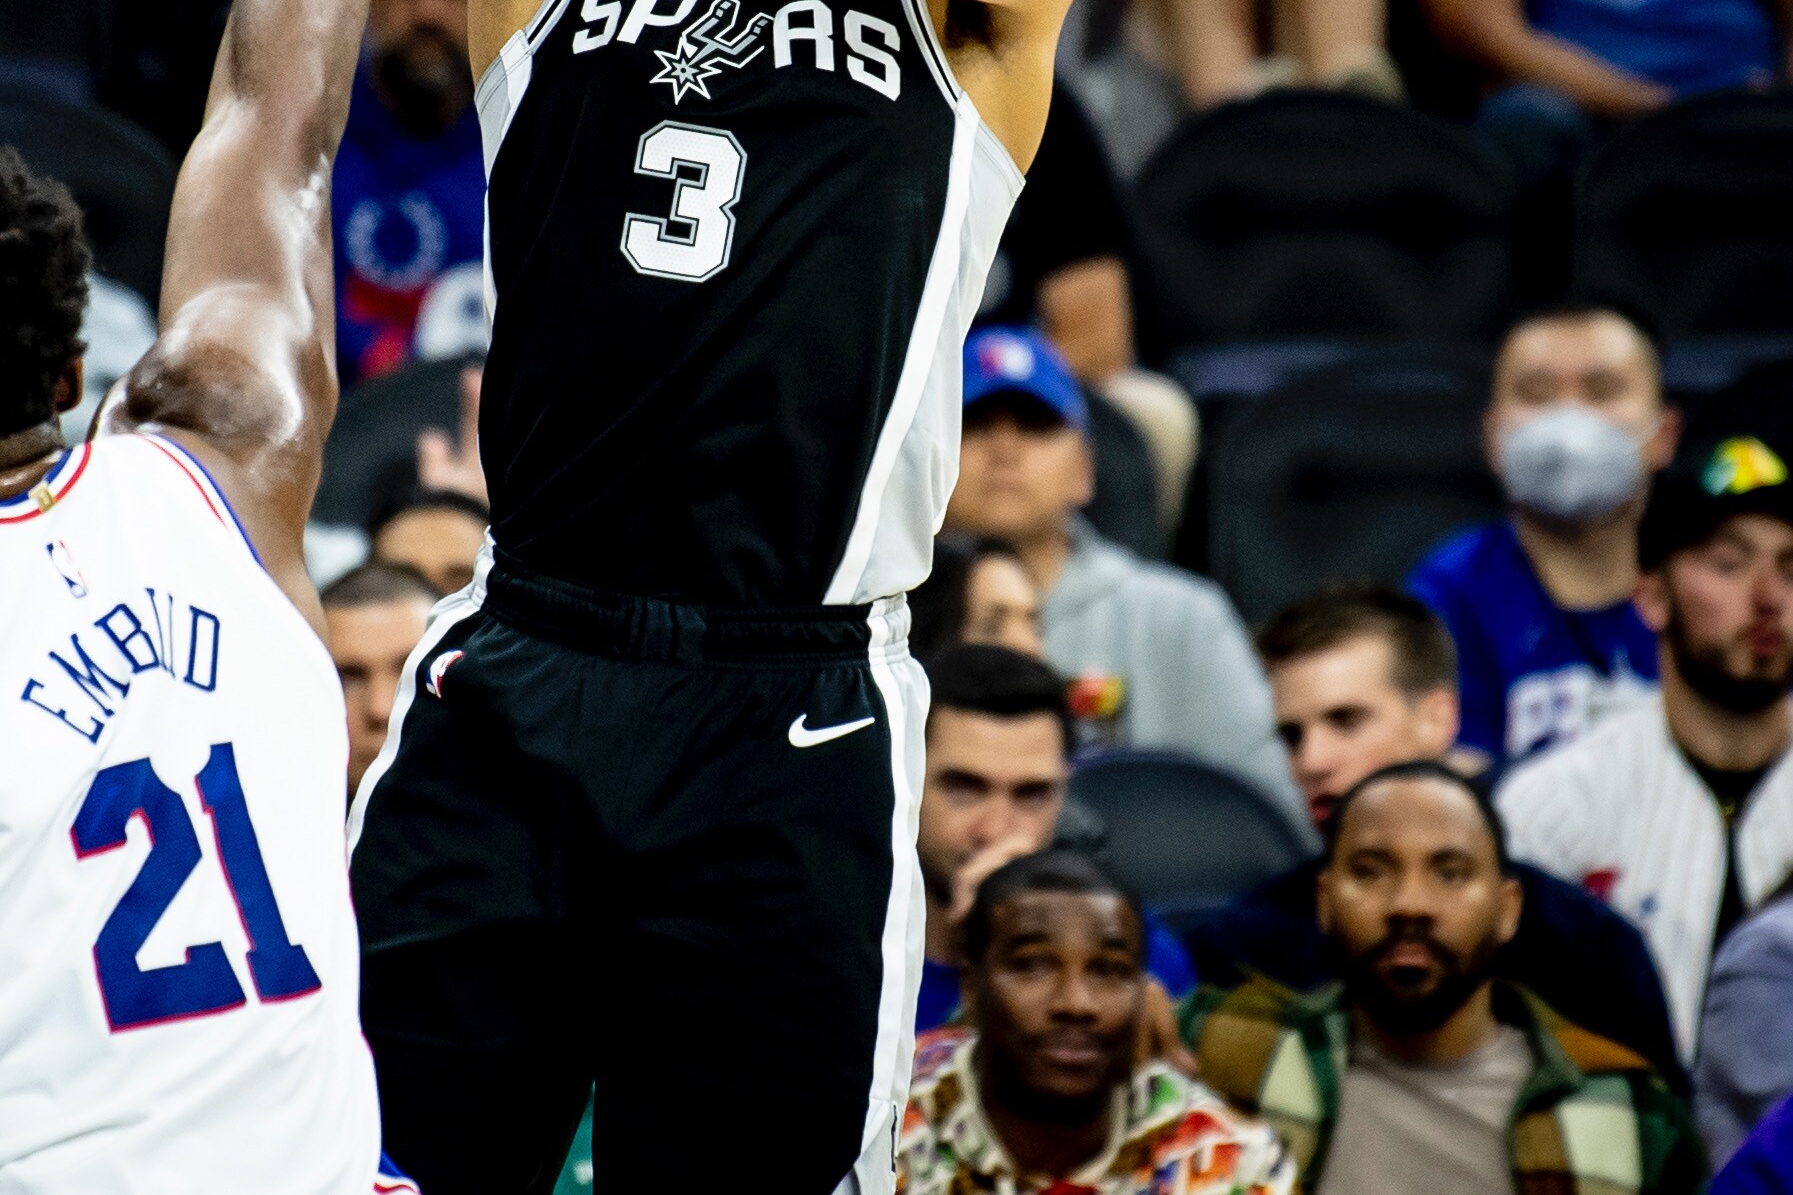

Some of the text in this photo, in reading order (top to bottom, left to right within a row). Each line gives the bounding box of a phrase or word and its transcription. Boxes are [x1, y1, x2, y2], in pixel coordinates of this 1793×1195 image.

[619, 119, 748, 283] 3
[21, 587, 221, 744] EMBIID
[70, 740, 323, 1035] 21
